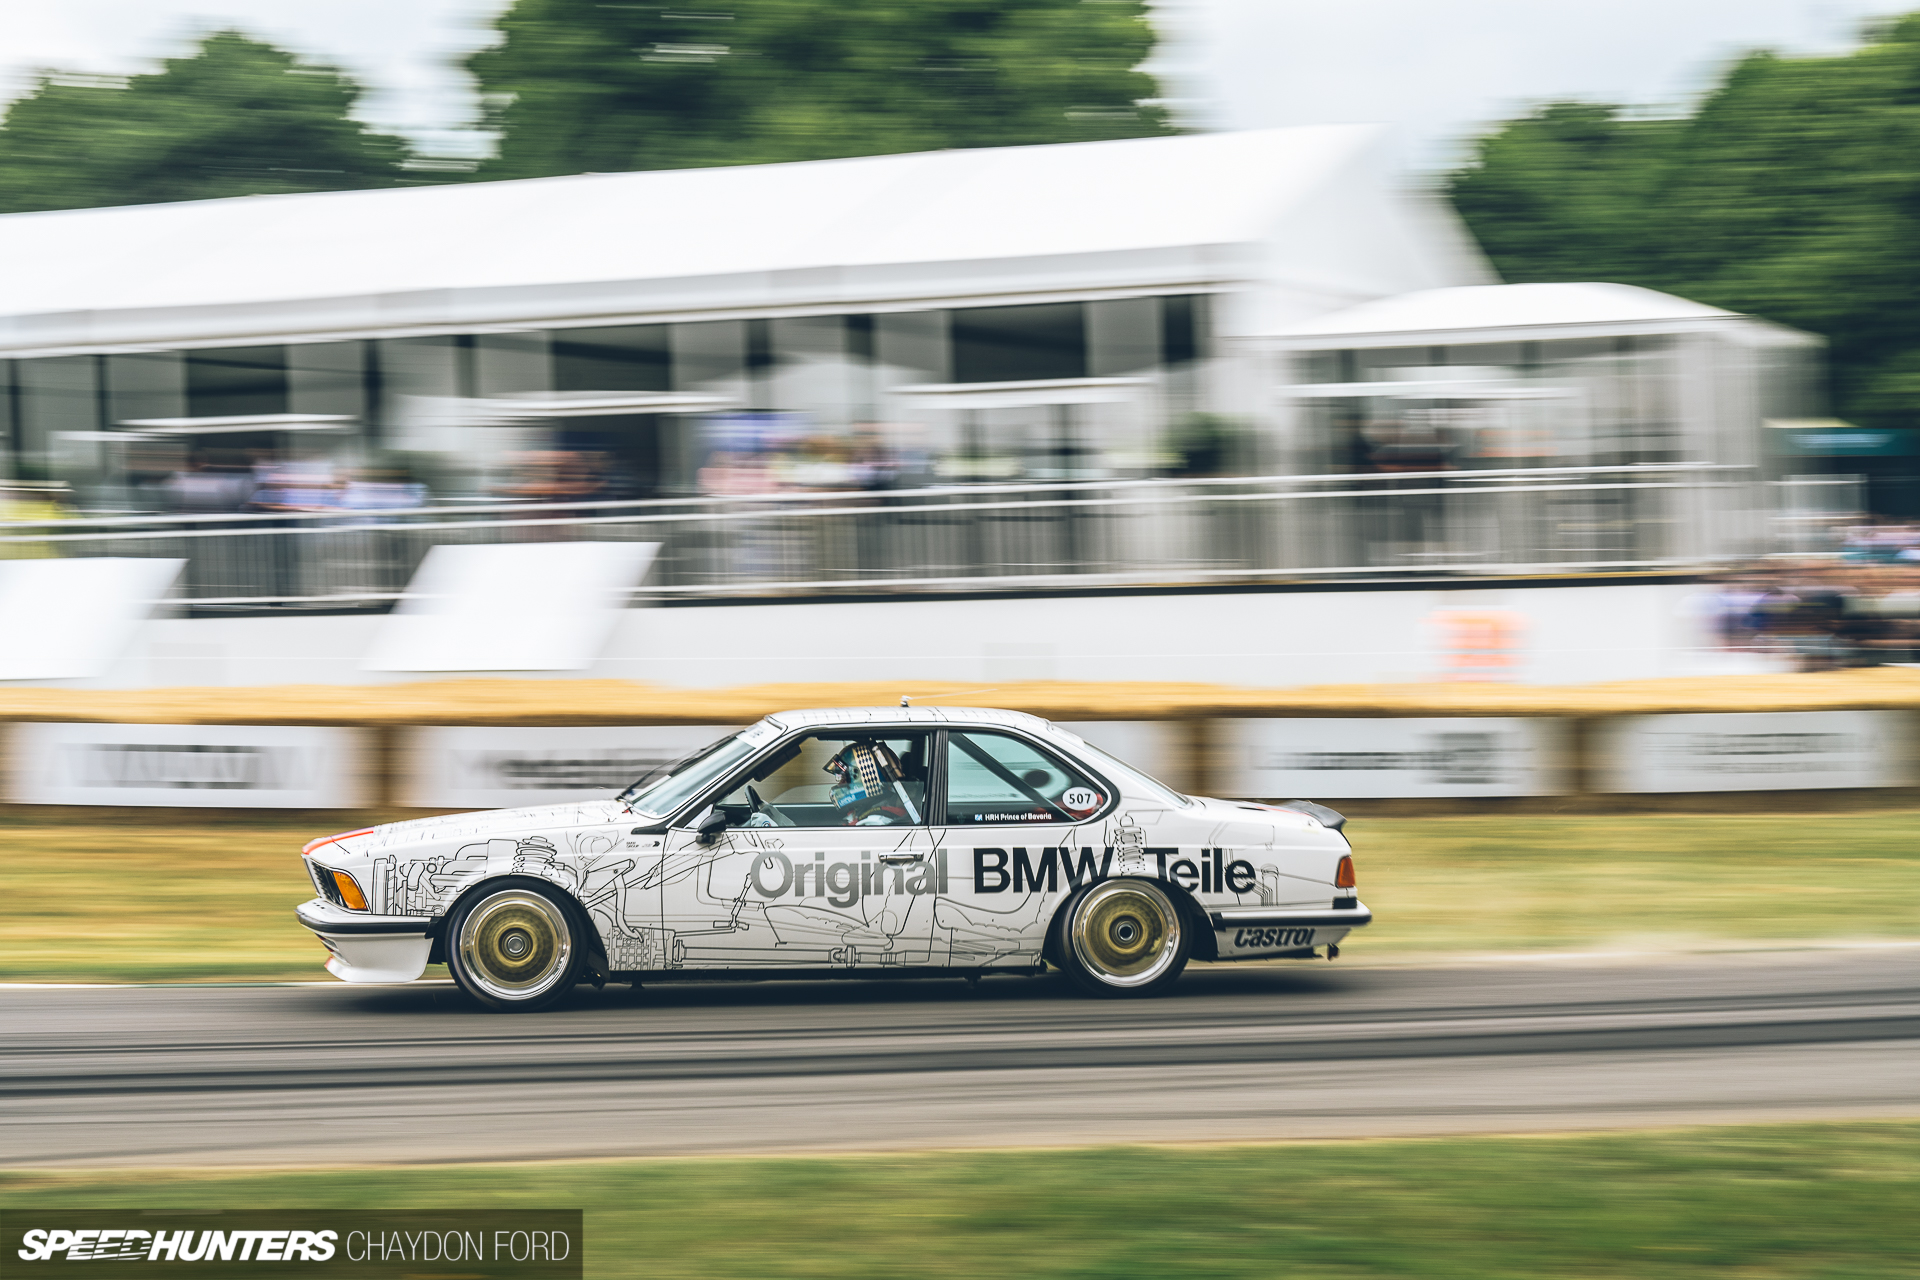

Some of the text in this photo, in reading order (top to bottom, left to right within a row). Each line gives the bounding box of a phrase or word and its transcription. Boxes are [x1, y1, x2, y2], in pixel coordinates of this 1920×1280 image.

[1068, 793, 1091, 805] 507
[1000, 813, 1020, 821] Prince
[1020, 812, 1027, 820] of
[750, 846, 1257, 908] Original BMW Teile
[1233, 927, 1317, 949] Castrol
